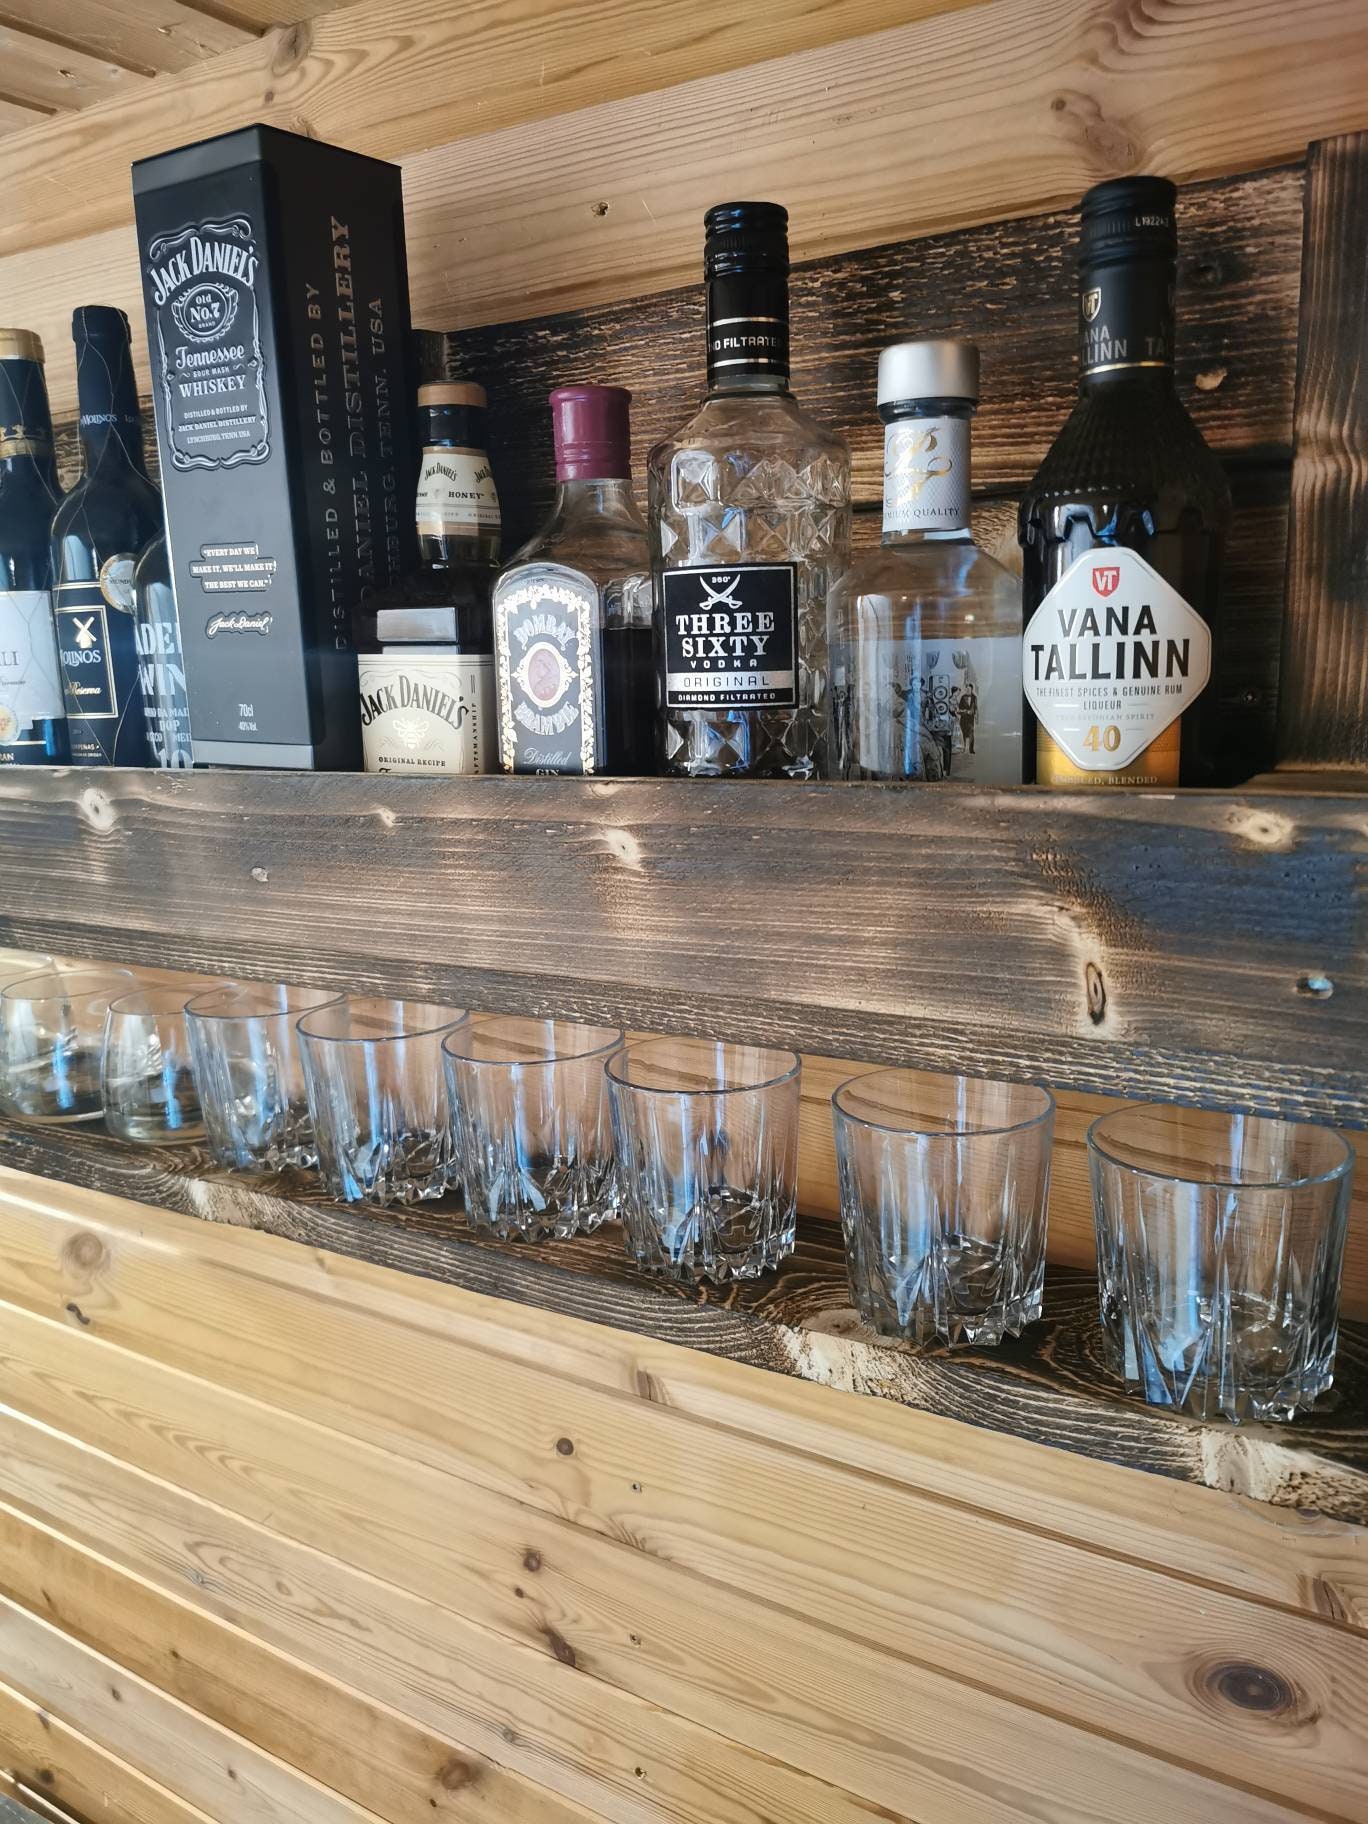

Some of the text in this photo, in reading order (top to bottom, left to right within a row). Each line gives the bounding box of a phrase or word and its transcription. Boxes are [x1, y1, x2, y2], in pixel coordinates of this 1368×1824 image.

[150, 236, 259, 306] JACK DANIEL'S
[195, 294, 212, 305] Old
[198, 321, 216, 329] BRAND
[368, 297, 386, 356] USA
[331, 216, 367, 458] DISTILLERY
[175, 345, 245, 369] Tennessee
[193, 366, 230, 378] SOUR MASH
[179, 374, 246, 398] WHISKEY
[183, 409, 211, 419] DISTILLED
[215, 405, 240, 415] BOTTLED
[240, 404, 248, 412] BY
[178, 416, 256, 432] JACK DANIEL DISTILLERY
[305, 282, 347, 650] DISTILLED & BOTTLED BY
[424, 462, 457, 482] JACK DANIEL'S
[448, 491, 481, 500] HONEY
[913, 507, 960, 519] QUALITY
[229, 547, 243, 556] DAY
[243, 547, 256, 555] WE
[192, 565, 211, 574] MAKE
[244, 563, 264, 572] MAKE
[264, 562, 273, 571] IT
[204, 581, 219, 589] THE
[219, 580, 237, 589] BEST
[237, 580, 248, 588] WE
[1095, 570, 1117, 592] VT
[208, 617, 235, 635] Jack
[675, 611, 775, 636] THREE
[1057, 604, 1158, 638] VANA
[513, 614, 577, 651] BOMBAY
[681, 635, 771, 658] SIXTY
[690, 658, 758, 669] VODKA
[1030, 638, 1190, 681] TALLINN
[683, 675, 770, 688] ORIGINAL
[677, 692, 776, 702] DIAMOND FILTRATED
[1036, 684, 1183, 697] THE FINEST SPICES & GENUINE RUM
[359, 674, 470, 730] JACK DANIEL'S
[1083, 700, 1122, 711] LIQUEUR
[238, 703, 254, 717] 70cl
[1083, 725, 1121, 752] 40
[378, 756, 446, 767] ORIGINAL RECIPE
[523, 747, 573, 766] Distilled
[535, 768, 560, 776] GIN
[1108, 775, 1158, 785] BLENDED
